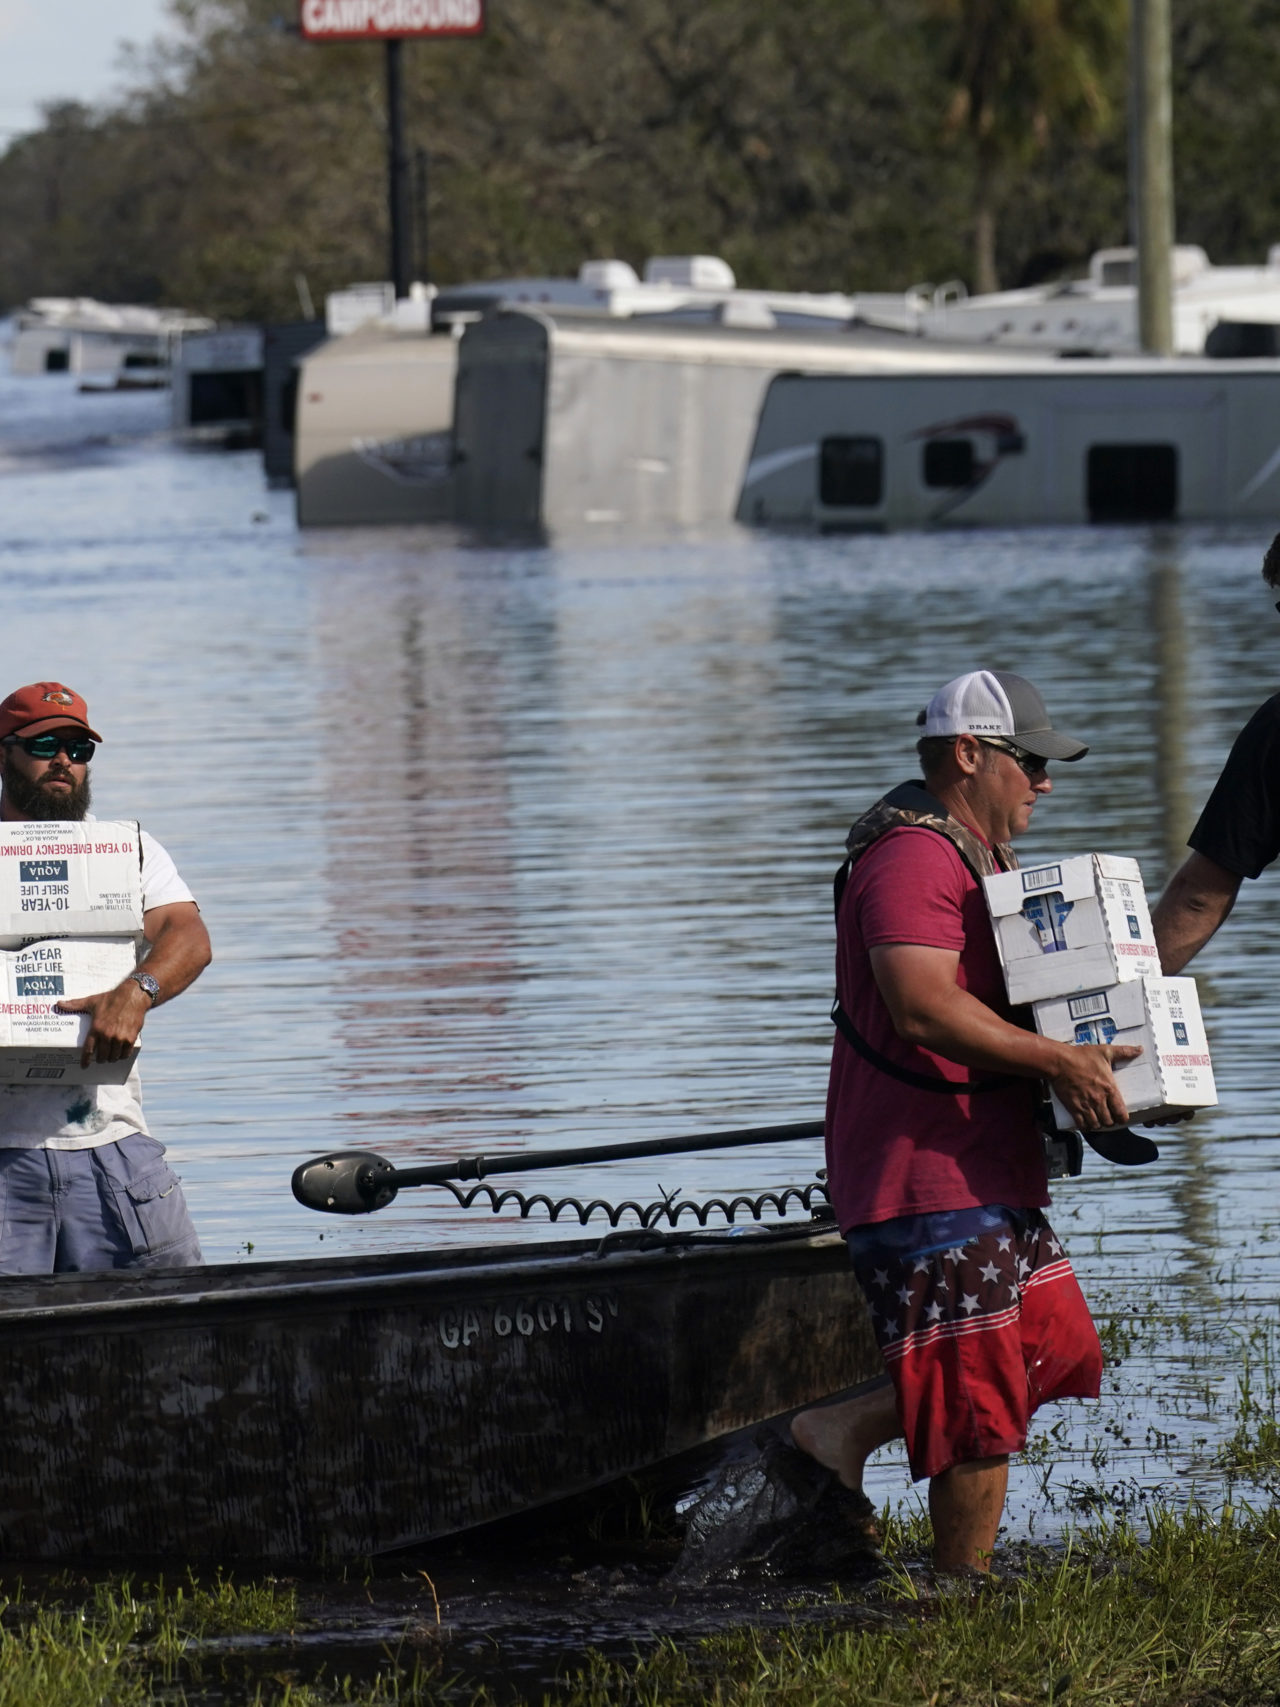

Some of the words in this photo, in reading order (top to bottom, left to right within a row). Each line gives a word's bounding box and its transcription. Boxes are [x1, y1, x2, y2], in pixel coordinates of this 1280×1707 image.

[302, 0, 481, 32] CAMPGROUND
[36, 843, 92, 855] EMERGENCY
[95, 843, 120, 854] YEAR
[122, 843, 133, 853] 10
[29, 866, 61, 876] AQUA
[20, 885, 39, 896] LIFE
[41, 884, 70, 895] SHELF
[21, 897, 70, 911] 10-YEAR
[16, 948, 62, 963] 10-YEAR
[15, 963, 42, 974] SHELF
[44, 962, 63, 973] LIFE
[24, 981, 55, 991] AQUA
[439, 1305, 480, 1349] GA
[494, 1298, 571, 1337] 6601
